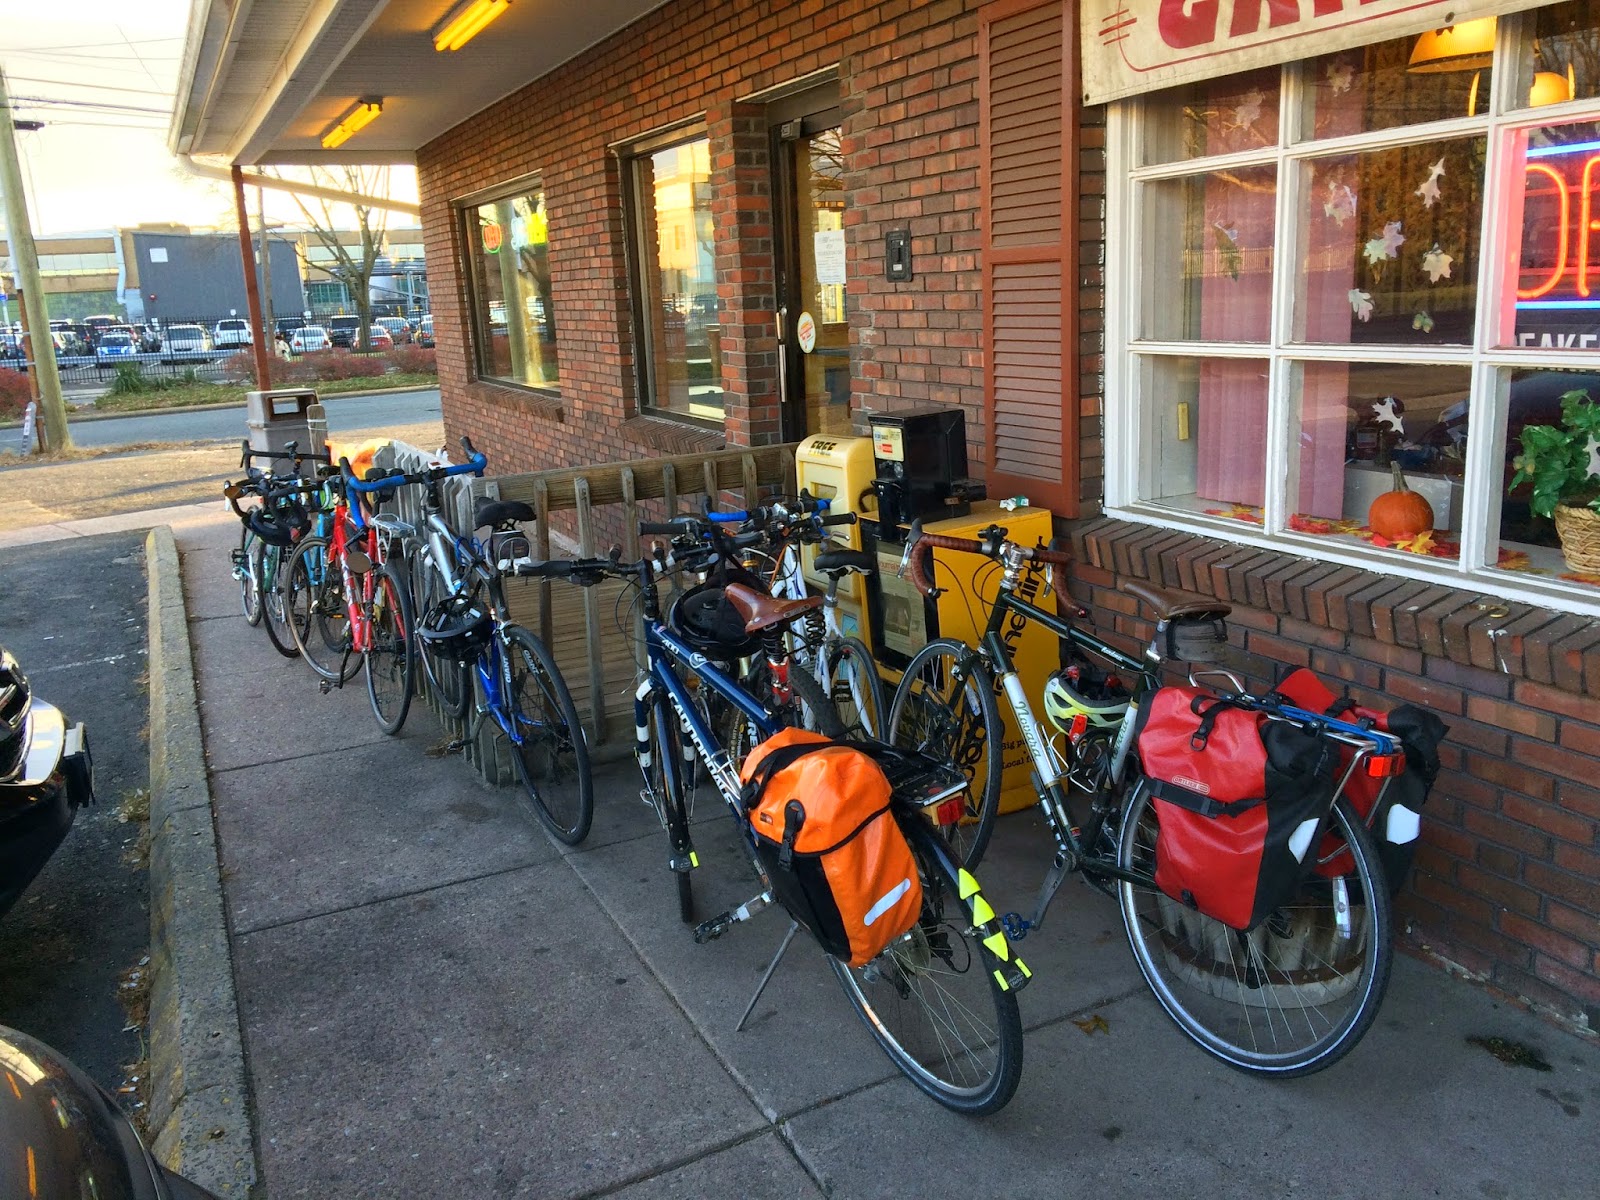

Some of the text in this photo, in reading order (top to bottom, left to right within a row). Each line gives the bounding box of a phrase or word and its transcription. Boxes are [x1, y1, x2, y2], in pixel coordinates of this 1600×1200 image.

[810, 440, 838, 451] FREE
[503, 656, 511, 683] GIANT
[524, 650, 539, 674] GIANT
[1015, 701, 1041, 757] Novara
